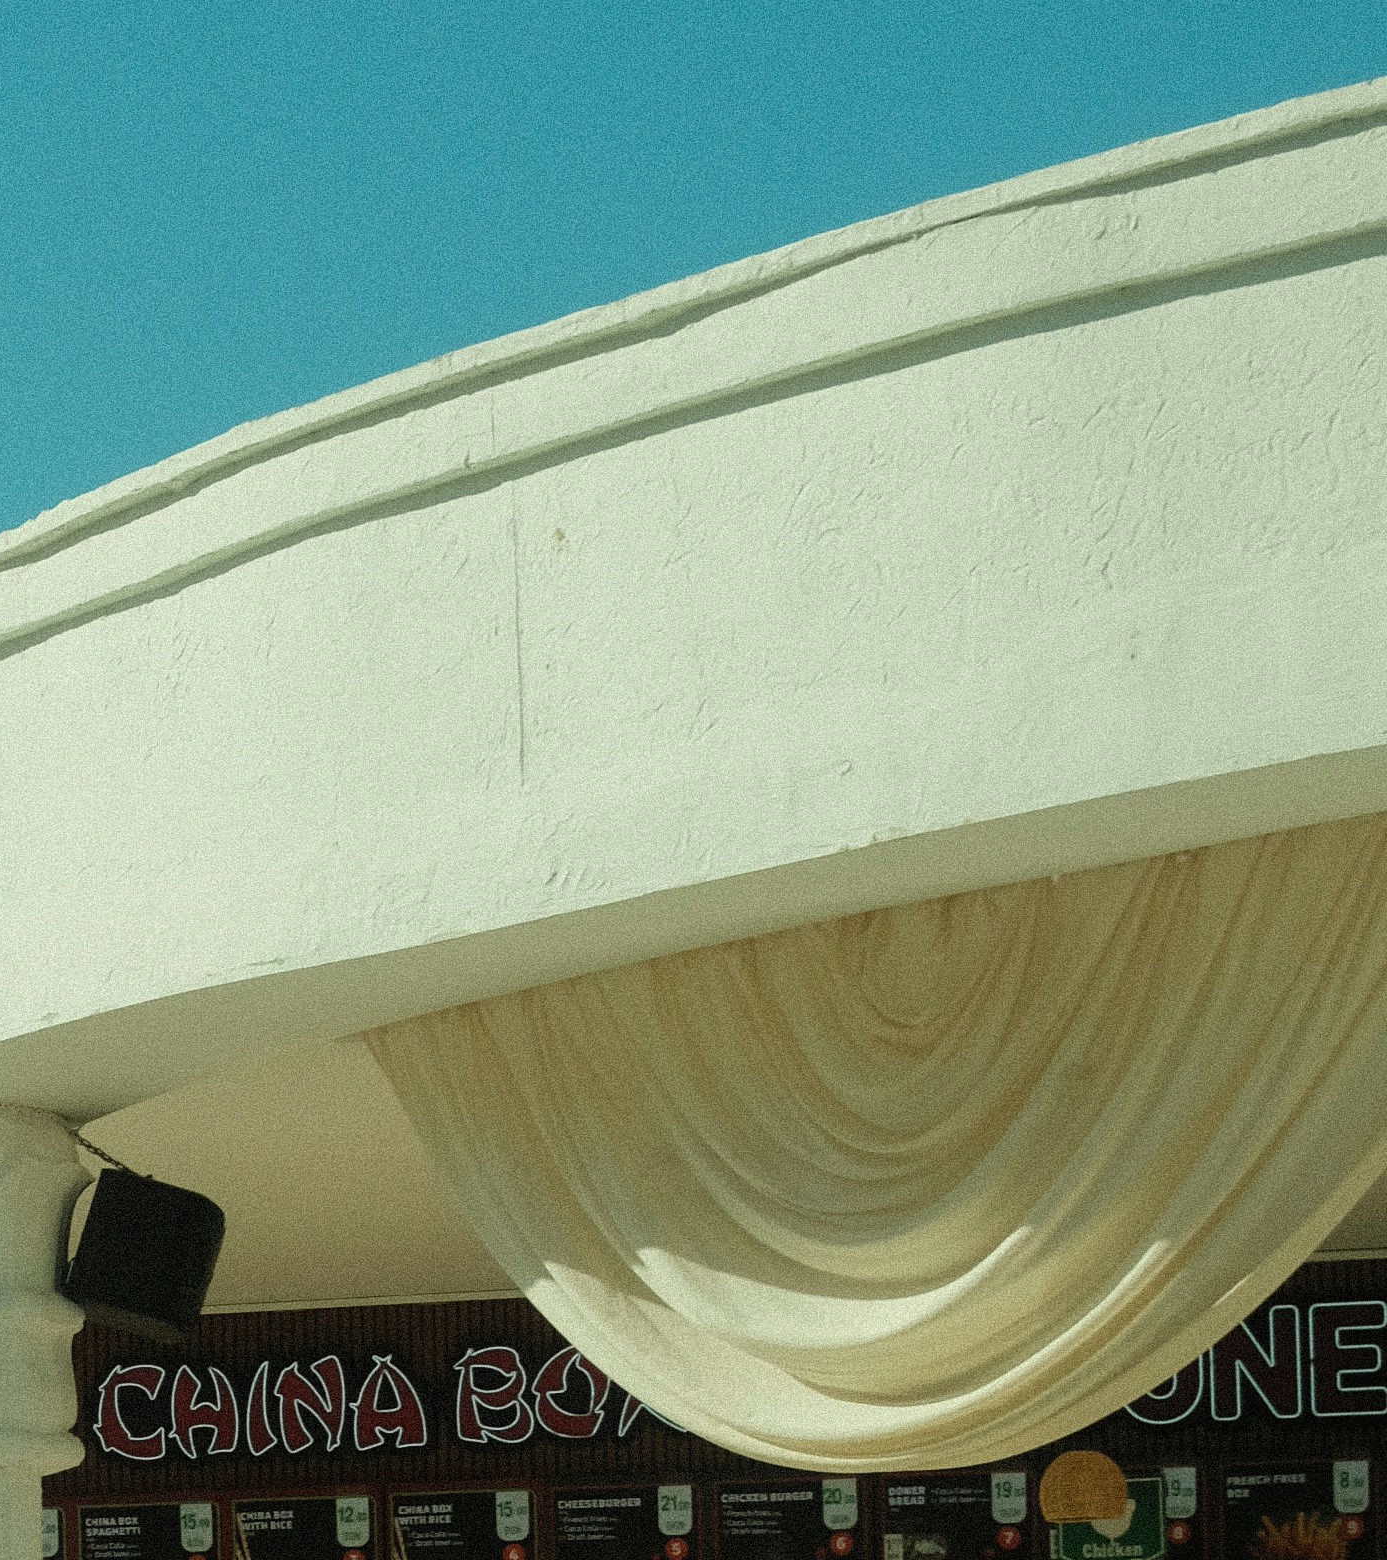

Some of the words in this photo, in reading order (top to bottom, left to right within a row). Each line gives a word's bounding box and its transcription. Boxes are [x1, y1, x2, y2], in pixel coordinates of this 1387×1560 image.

[93, 1354, 427, 1460] CHINA
[397, 1505, 430, 1515] CHINA
[431, 1503, 454, 1514] BOX
[556, 1496, 642, 1510] CHEESEBURGER
[85, 1516, 116, 1527] CHINA
[117, 1515, 139, 1526] BOX
[242, 1511, 271, 1521] CHINA
[273, 1509, 294, 1519] BOX
[428, 1514, 453, 1524] RICE
[85, 1525, 142, 1537] SPAGHETTI
[270, 1520, 293, 1530] RICE
[1004, 1531, 1015, 1544] 7
[671, 1543, 682, 1556] 5
[836, 1539, 847, 1551] 6
[1082, 1542, 1144, 1558] Chicken
[509, 1549, 519, 1560] 4
